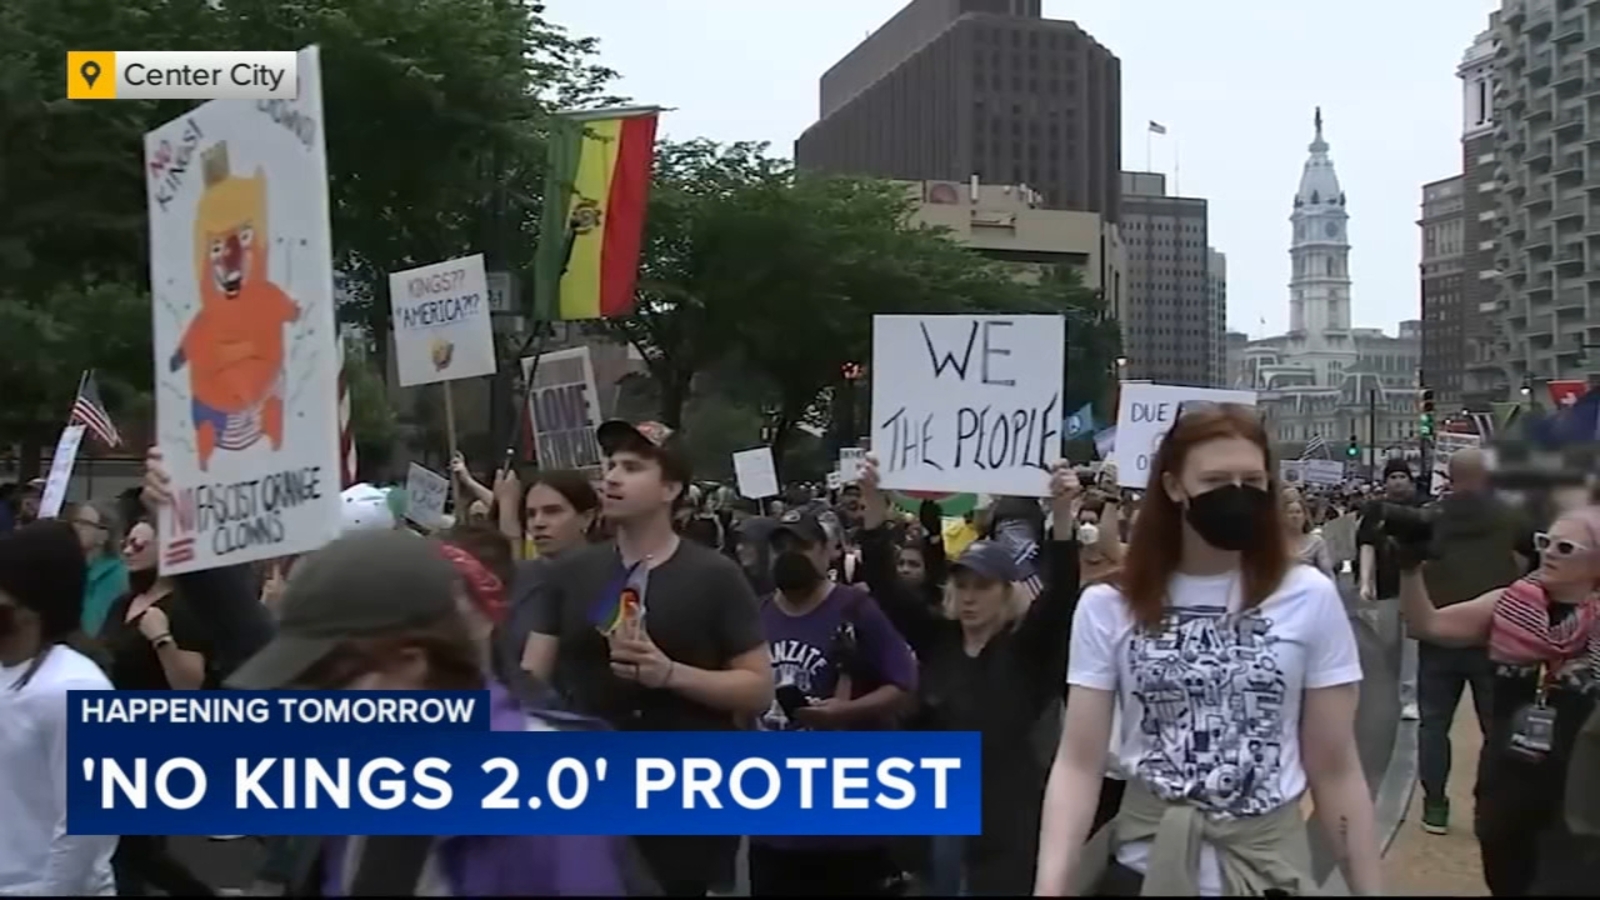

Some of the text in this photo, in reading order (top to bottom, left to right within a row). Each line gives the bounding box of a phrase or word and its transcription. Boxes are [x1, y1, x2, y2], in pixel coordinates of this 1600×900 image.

[920, 320, 1016, 387] WE
[531, 383, 594, 434] LOVE
[882, 407, 944, 473] THE
[954, 392, 1058, 475] PEOPLE
[1131, 402, 1170, 422] DUE
[197, 480, 259, 533] FASCIST
[262, 466, 321, 512] ORANGE
[213, 509, 285, 556] CLOWNS
